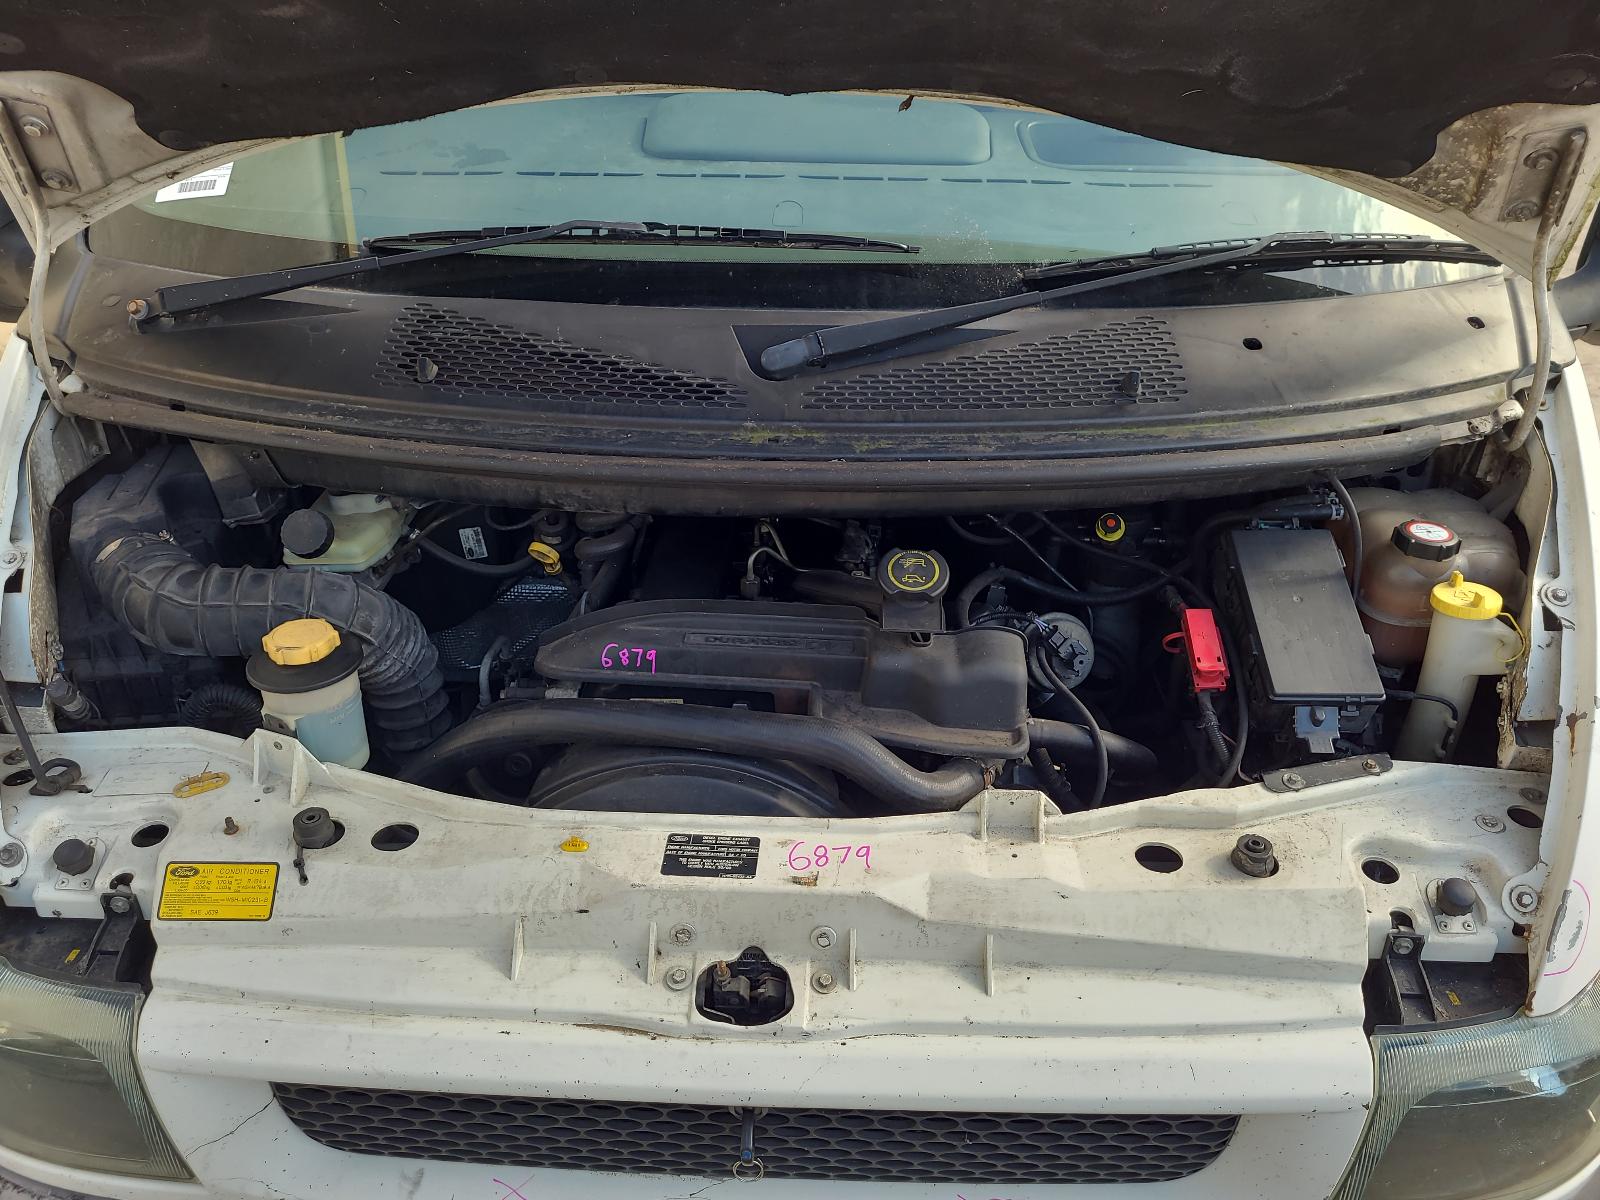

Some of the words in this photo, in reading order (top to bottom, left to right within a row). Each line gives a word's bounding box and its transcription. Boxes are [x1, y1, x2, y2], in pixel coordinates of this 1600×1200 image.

[601, 643, 656, 675] 6879
[788, 841, 871, 870] 6879
[174, 867, 196, 877] Ford
